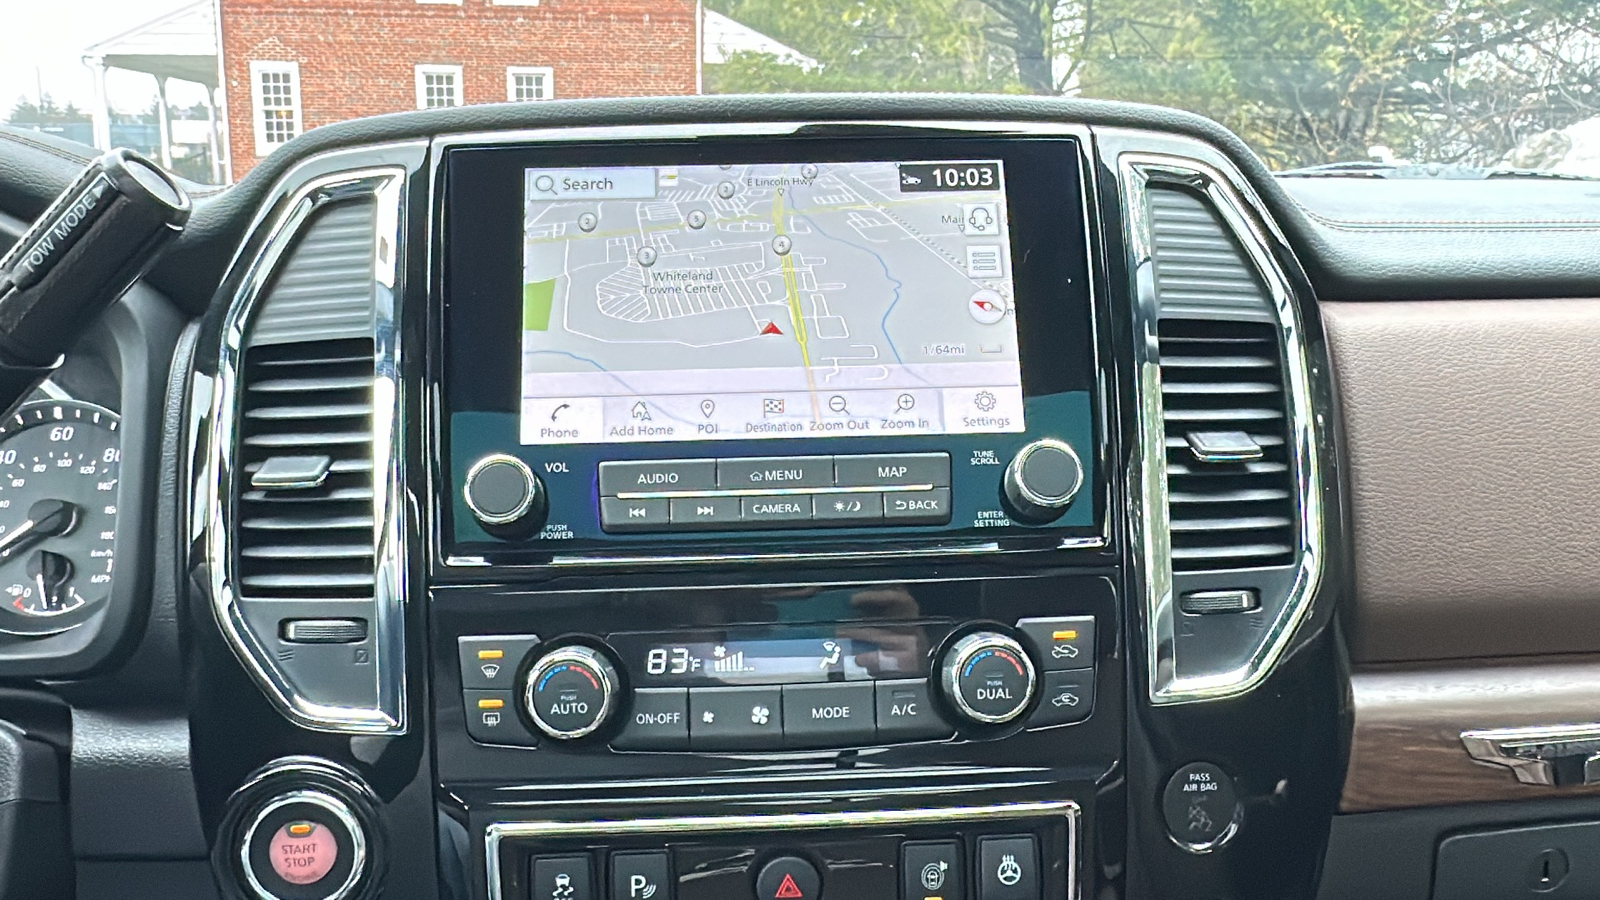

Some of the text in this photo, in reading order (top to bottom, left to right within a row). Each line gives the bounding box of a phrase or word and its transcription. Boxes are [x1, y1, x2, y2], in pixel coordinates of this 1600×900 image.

[747, 177, 814, 187] E Lincoln Hwy
[932, 167, 993, 187] 10:03
[562, 177, 614, 191] Search
[22, 196, 97, 274] TOW MODE
[653, 270, 714, 282] Whiteland
[642, 283, 724, 295] Towne Center
[923, 344, 965, 355] 1/64mi
[745, 422, 803, 433] Destination
[810, 420, 870, 432] Zoom Out
[881, 419, 930, 430] Zoom In
[962, 416, 1011, 428] Settings
[50, 426, 74, 442] 60
[540, 427, 579, 438] Phone
[610, 425, 674, 437] Add Home
[697, 423, 718, 434] POI
[973, 450, 995, 458] TUNE
[57, 458, 73, 468] 100
[970, 457, 1000, 465] SCROLL
[79, 465, 96, 475] 120
[545, 462, 570, 473] VOL
[877, 466, 908, 478] MAP
[637, 472, 679, 484] AUDIO
[764, 469, 803, 481] MENU
[752, 503, 801, 514] CAMERA
[908, 500, 938, 510] BACK
[977, 510, 1004, 519] ENTER
[546, 524, 568, 532] PUSH
[973, 518, 1010, 528] SETTING
[540, 531, 574, 540] POWER
[90, 548, 113, 558] km/h
[976, 687, 1013, 700] DUAL
[550, 702, 588, 715] AUTO
[811, 706, 850, 719] MODE
[890, 703, 917, 716] A/C
[636, 712, 681, 725] ON-OFF
[1189, 773, 1211, 782] PASS
[1183, 782, 1218, 792] AIR BAG
[281, 842, 318, 856] START
[284, 857, 316, 868] STOP
